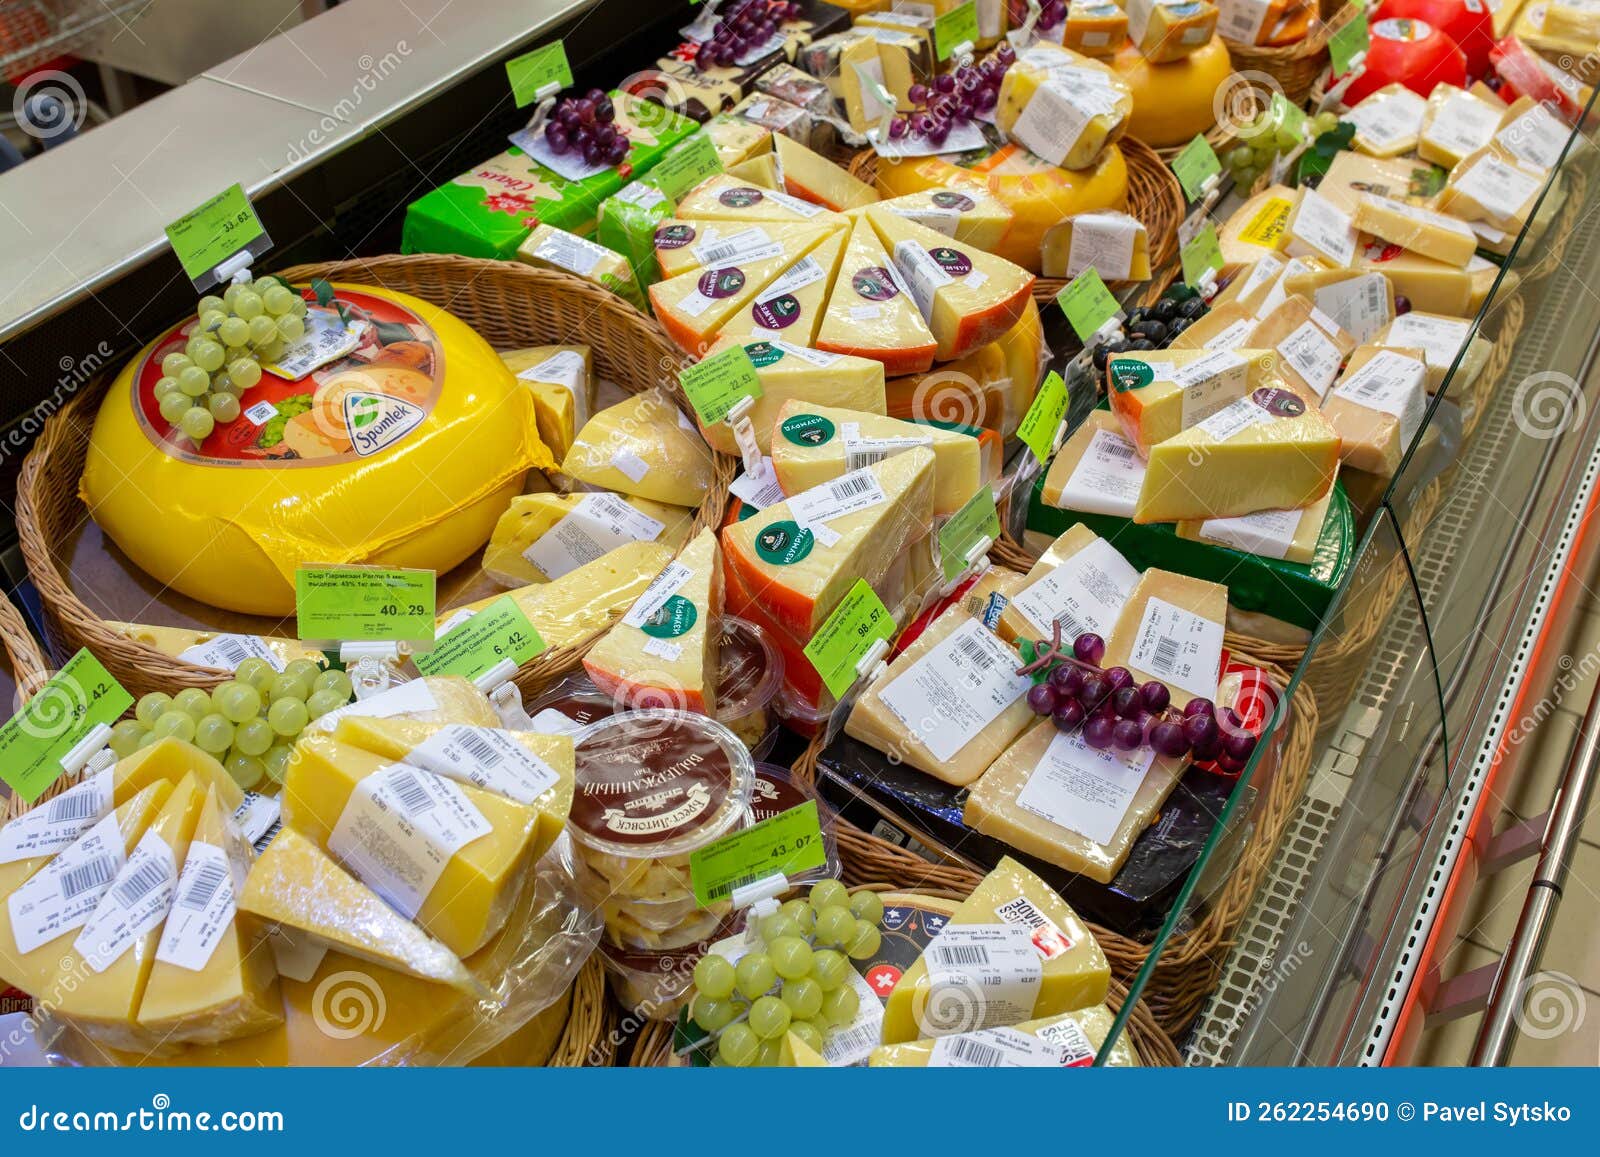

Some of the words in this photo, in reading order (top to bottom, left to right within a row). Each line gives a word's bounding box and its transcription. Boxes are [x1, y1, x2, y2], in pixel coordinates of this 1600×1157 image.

[222, 220, 235, 233] 33
[236, 210, 249, 223] 63
[356, 404, 411, 449] Spomlek
[784, 417, 824, 431] ИЗУМРУД
[784, 527, 808, 564] ИЗУМРУД
[324, 572, 360, 580] Пармезан
[380, 604, 396, 615] 40
[408, 604, 424, 615] 29
[672, 599, 686, 634] ИЗУМРУД
[855, 623, 870, 637] 98
[868, 608, 882, 623] 57
[492, 644, 503, 656] 6
[506, 630, 523, 646] 42
[68, 702, 88, 721] 39
[89, 681, 109, 701] 42
[583, 752, 704, 797] ВЫДЕРЖАННЫЙ
[615, 798, 707, 831] Брест-Литовск
[769, 844, 787, 858] 43
[794, 834, 812, 848] 07
[1017, 898, 1047, 928] MADE
[983, 975, 1001, 985] 11.03
[1061, 1021, 1090, 1059] MADE
